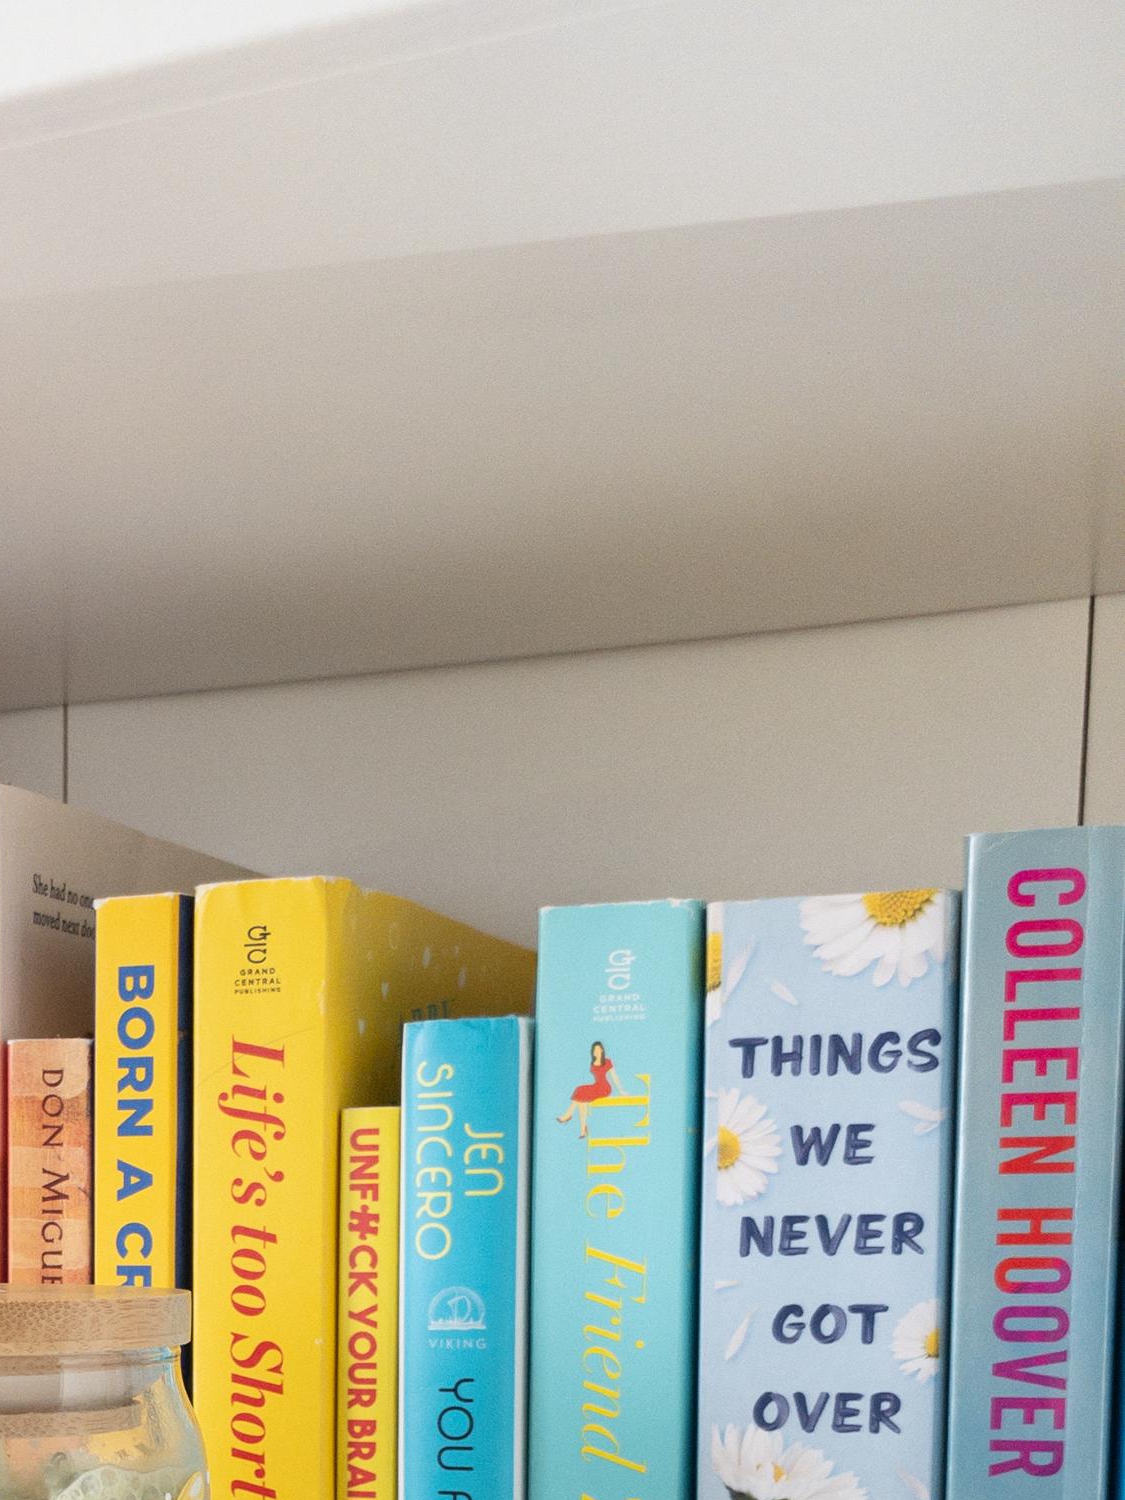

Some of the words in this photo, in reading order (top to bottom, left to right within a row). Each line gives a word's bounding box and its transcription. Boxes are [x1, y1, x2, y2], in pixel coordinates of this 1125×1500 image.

[234, 977, 281, 987] CENTRAL
[234, 986, 281, 995] PUBLISHING
[239, 967, 276, 977] GRAND
[116, 965, 154, 1137] BORN
[727, 1027, 943, 1080] THINGS
[998, 867, 1087, 1176] COLLEEN
[41, 1069, 64, 1147] DON
[218, 1033, 286, 1208] Life's
[585, 1074, 651, 1220] The
[789, 1122, 876, 1167] WE
[116, 1159, 154, 1201] A
[416, 1060, 454, 1260] SINCERO
[463, 1122, 505, 1198] JEN
[41, 1167, 70, 1285] MIGUE
[739, 1211, 925, 1258] NEVER
[230, 1225, 278, 1317] too
[347, 1304, 379, 1409] YOUR
[428, 1337, 488, 1350] VIKING
[580, 1238, 648, 1474] Friend
[771, 1303, 889, 1345] GOT
[988, 1207, 1074, 1478] HOOVER
[437, 1378, 475, 1471] YOU
[752, 1391, 902, 1434] OVER
